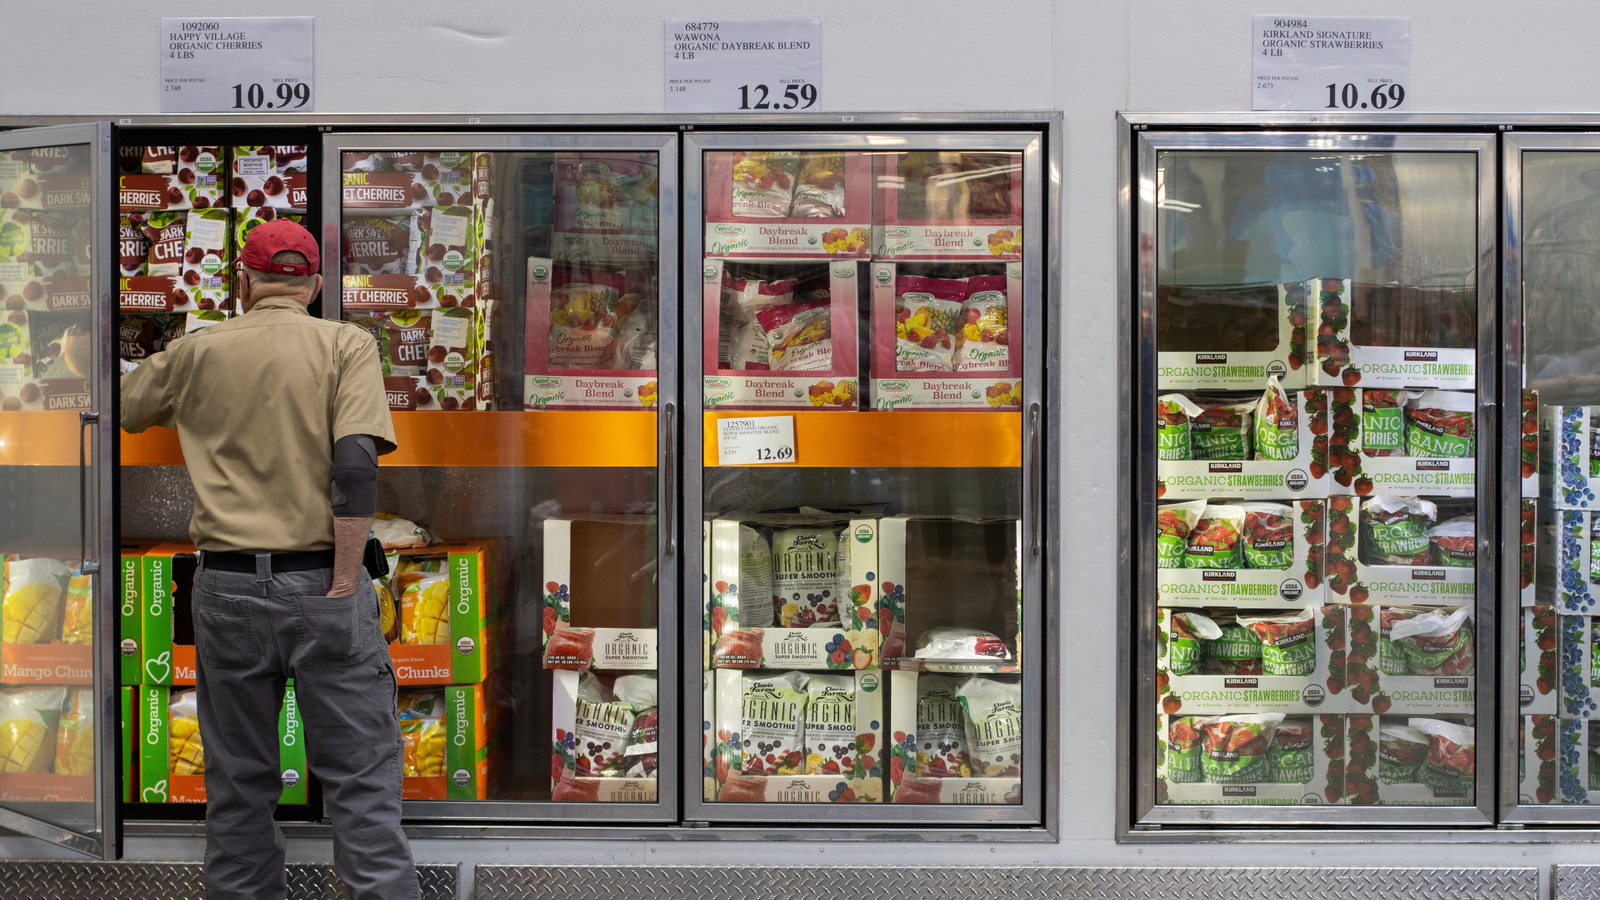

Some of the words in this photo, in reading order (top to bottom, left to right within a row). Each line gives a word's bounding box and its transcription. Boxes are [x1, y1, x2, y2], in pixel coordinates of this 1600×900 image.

[182, 22, 219, 30] 1092060
[685, 22, 719, 31] 684779
[1274, 20, 1307, 28] 904984
[1316, 31, 1372, 40] SIGNATURE
[1310, 41, 1383, 49] STRAWBERRIES
[232, 83, 310, 108] 10.99
[738, 84, 817, 110] 12.59
[1326, 83, 1405, 109] 10.69
[357, 188, 405, 201] CHERRIES
[732, 186, 766, 199] Organic
[47, 193, 72, 205] DARK
[759, 227, 808, 236] Daybreak
[925, 229, 973, 239] Daybreak
[712, 239, 749, 256] Organic
[878, 241, 914, 258] Organic
[52, 295, 79, 307] DARK
[360, 290, 408, 303] CHERRIES
[401, 329, 424, 342] DARK
[557, 333, 592, 346] Organic
[896, 345, 929, 359] Organic
[970, 348, 1007, 361] Organic
[1158, 367, 1211, 376] ORGANIC
[1213, 366, 1264, 377] STRAWBERRIES
[1362, 364, 1422, 374] ORGANIC
[576, 380, 624, 389] Daybreak
[745, 380, 794, 389] Daybreak
[923, 382, 972, 392] Daybreak
[49, 397, 75, 409] DARK
[529, 391, 565, 408] Organic
[876, 394, 913, 412] Organic
[1365, 432, 1398, 445] ERRIES
[757, 447, 793, 460] 12.69
[1167, 476, 1226, 486] ORGANIC
[1228, 475, 1284, 486] STRAWBERRIES
[1374, 473, 1433, 483] ORGANIC
[122, 561, 138, 617] Organic
[150, 560, 165, 616] Organic
[457, 558, 472, 615] Organic
[1161, 584, 1220, 594] ORGANIC
[1221, 584, 1278, 596] STRAWBERRIES
[1370, 582, 1429, 592] ORGANIC
[1275, 634, 1306, 646] KIRKLAND
[605, 643, 648, 655] ORGANIC
[774, 643, 817, 654] ORGANIC
[3, 664, 52, 679] Mango
[397, 666, 450, 679] Chunks
[1182, 691, 1242, 701] ORGANIC
[1244, 690, 1300, 702] STRAWBERRIES
[1392, 691, 1452, 701] ORGANIC
[147, 690, 162, 745] Organic
[284, 691, 298, 746] Organic
[454, 690, 468, 746] Organic
[754, 720, 795, 730] SMOOTHIE
[975, 738, 1000, 747] SUPER
[778, 791, 820, 802] ORGANIC
[953, 793, 996, 804] ORGANIC
